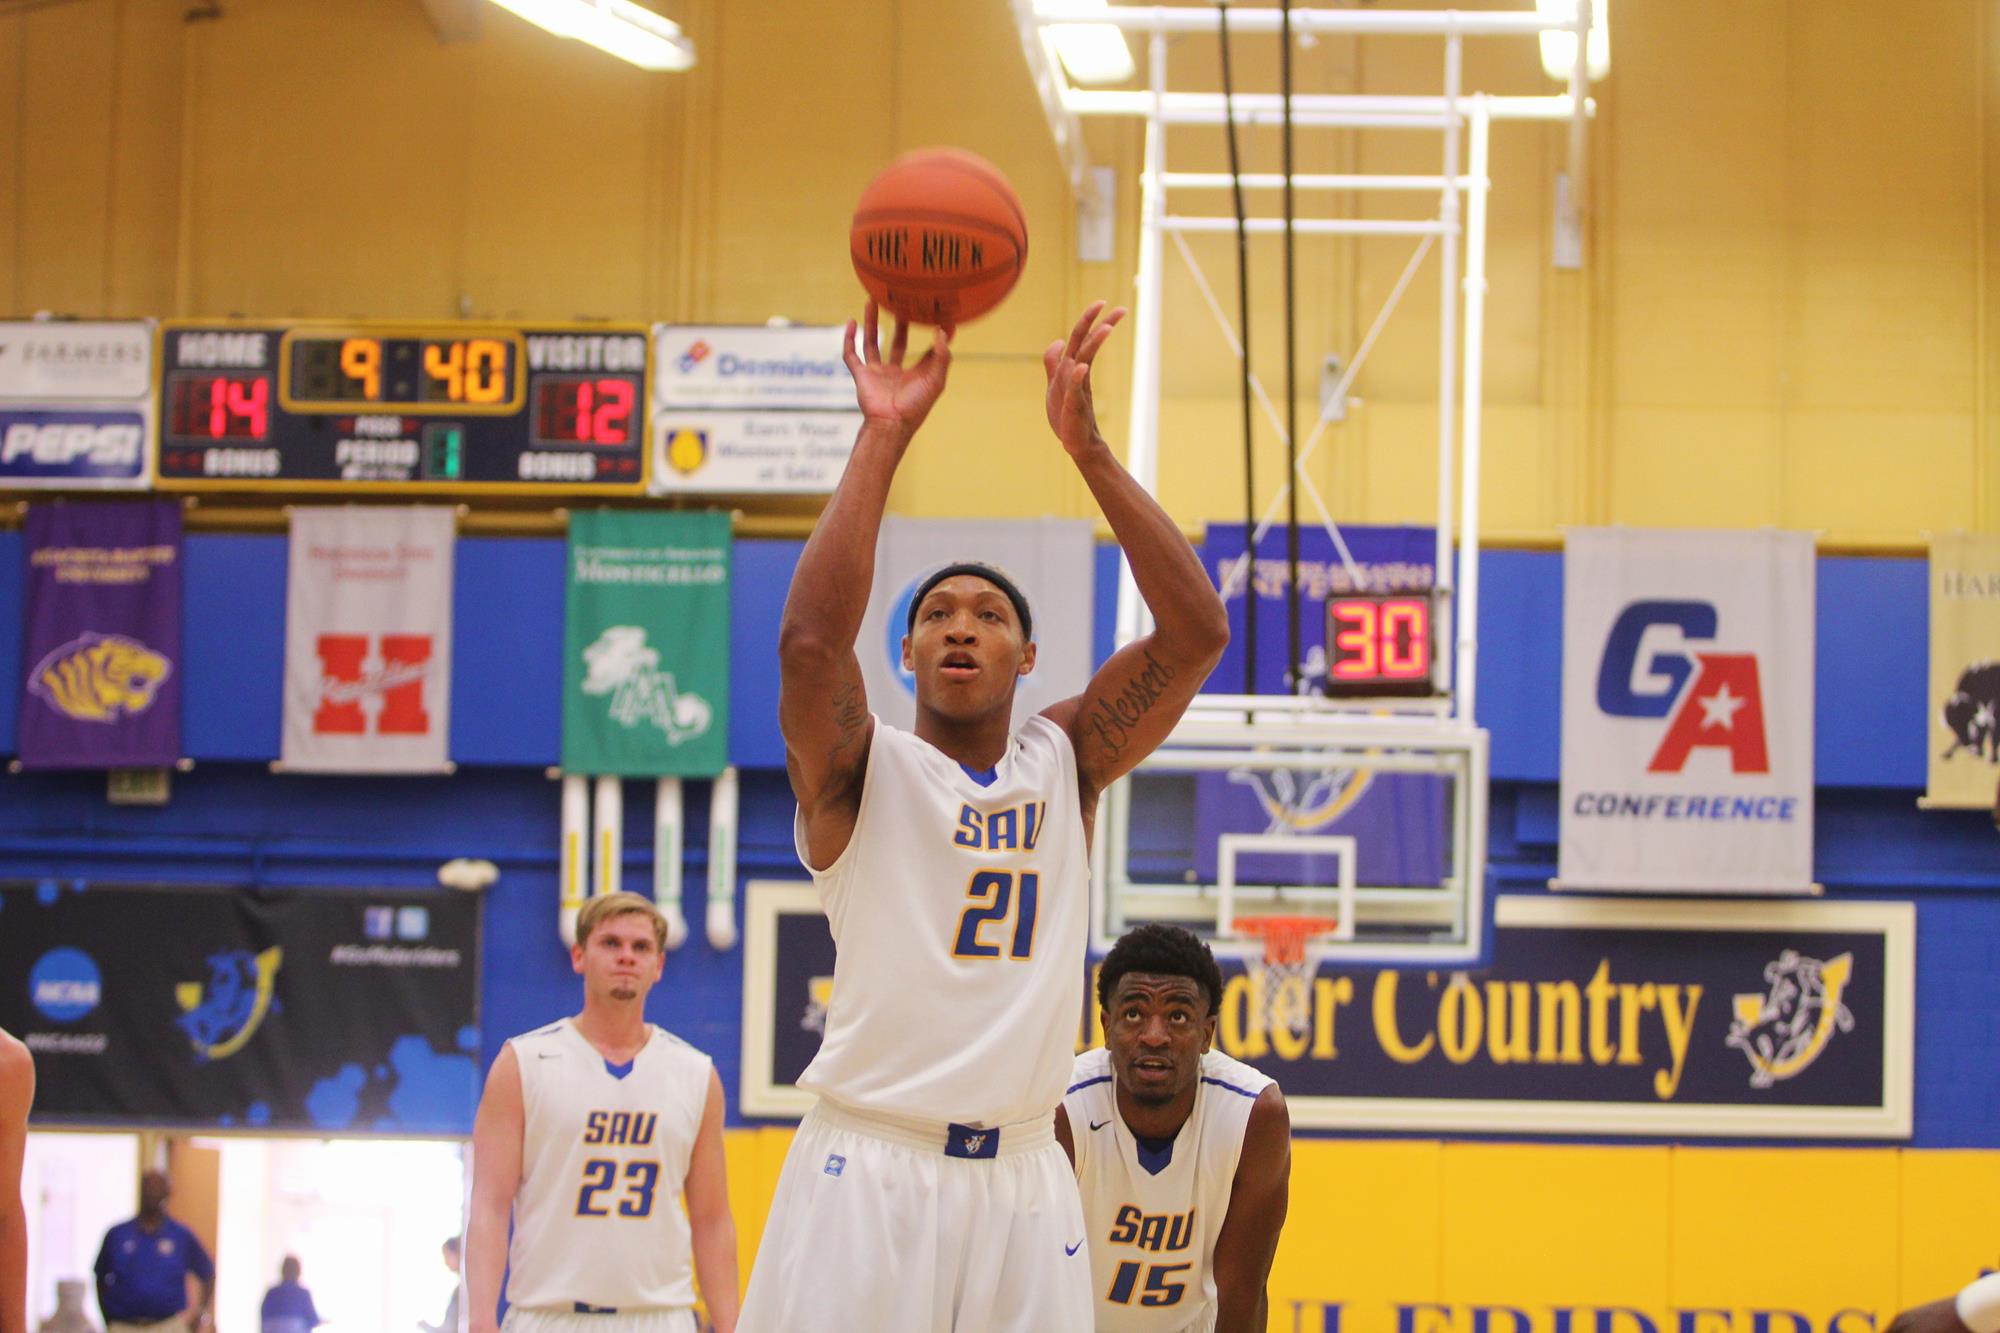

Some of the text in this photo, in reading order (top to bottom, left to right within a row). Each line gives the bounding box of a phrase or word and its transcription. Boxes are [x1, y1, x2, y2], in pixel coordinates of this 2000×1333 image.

[177, 332, 268, 367] HOME
[340, 338, 507, 402] 9 40
[527, 336, 644, 370] VISITOR
[209, 375, 269, 440] 14
[576, 378, 635, 445] 12
[2, 423, 141, 466] PEPSI
[203, 448, 281, 477] BONUS
[335, 438, 419, 467] PERIOD
[518, 451, 597, 481] BONUS
[1331, 600, 1428, 681] 30
[1085, 647, 1176, 764] Blessed
[952, 799, 1047, 853] SAU
[1574, 793, 1797, 823] CONFERENCE
[951, 867, 1040, 961] 21
[1371, 957, 1703, 1099] Country
[583, 1109, 659, 1147] SAU
[574, 1156, 661, 1221] 23
[1108, 1202, 1197, 1253] SAU
[1104, 1259, 1194, 1309] 15
